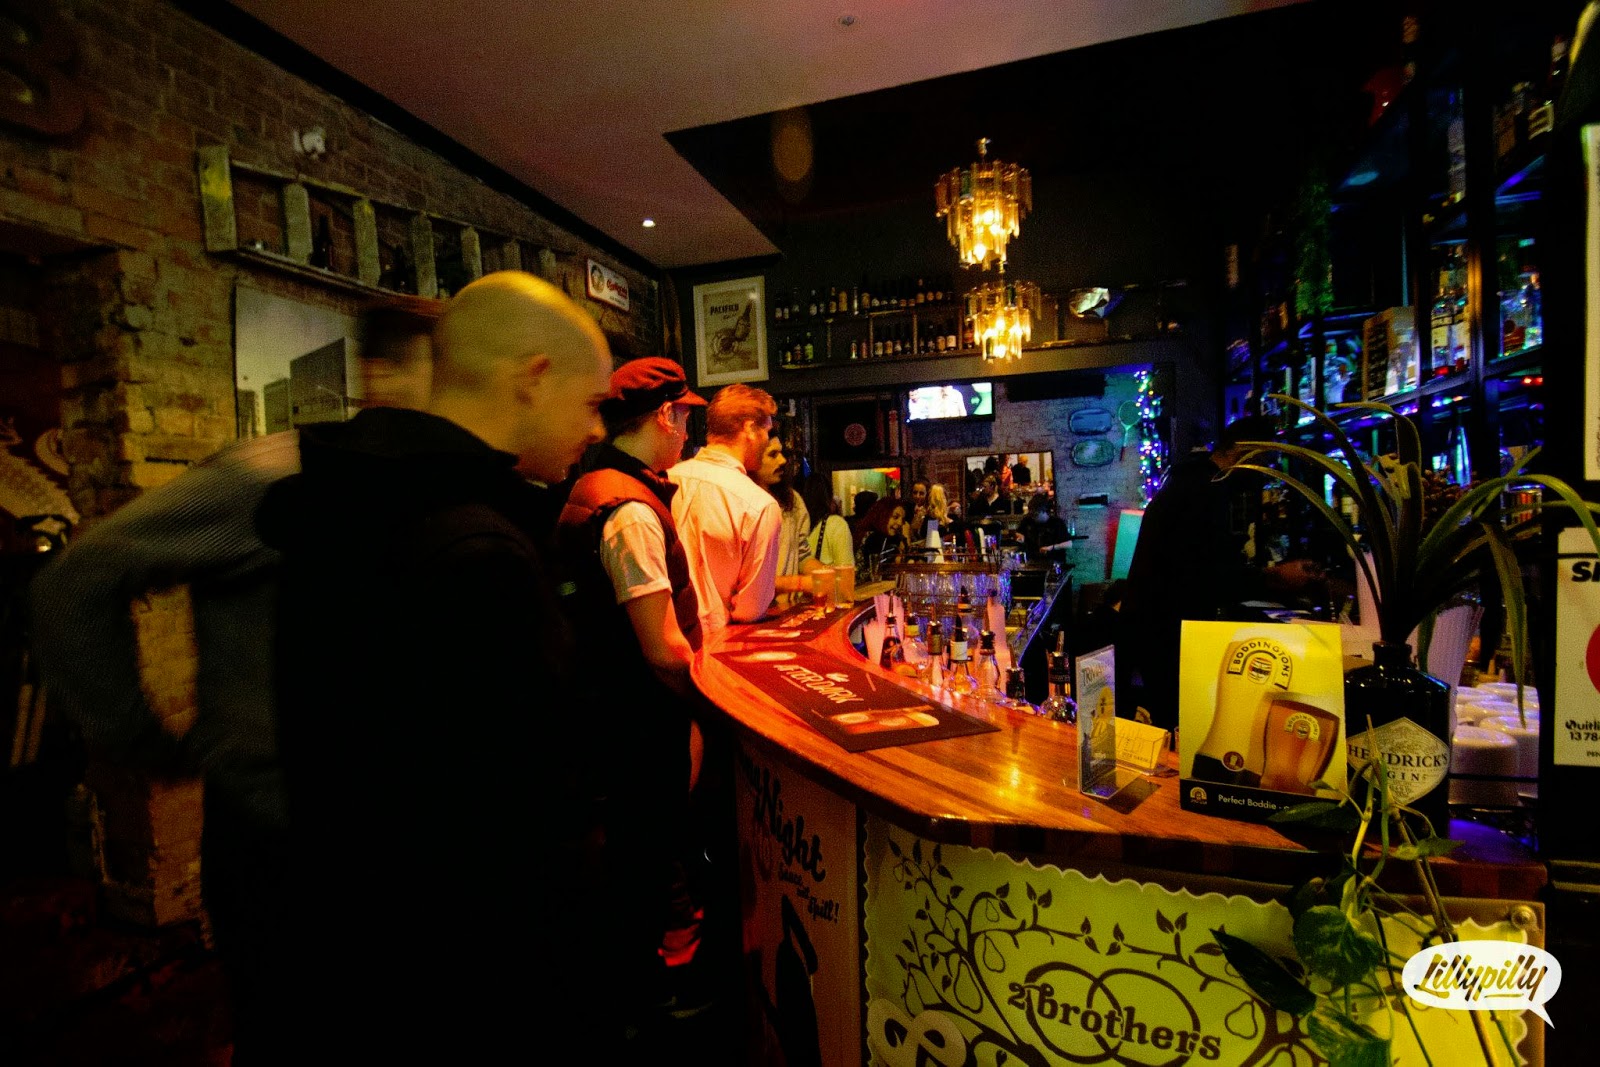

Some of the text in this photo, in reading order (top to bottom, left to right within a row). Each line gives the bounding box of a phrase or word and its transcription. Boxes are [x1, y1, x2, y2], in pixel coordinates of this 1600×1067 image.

[1233, 641, 1290, 677] BODDINGTONS
[1347, 744, 1448, 768] HEDRICK'S
[1387, 770, 1420, 781] GIN
[1218, 793, 1245, 806] Perfect
[1247, 798, 1277, 811] Boddie
[756, 768, 826, 882] Night
[1008, 982, 1221, 1060] 2 brothers
